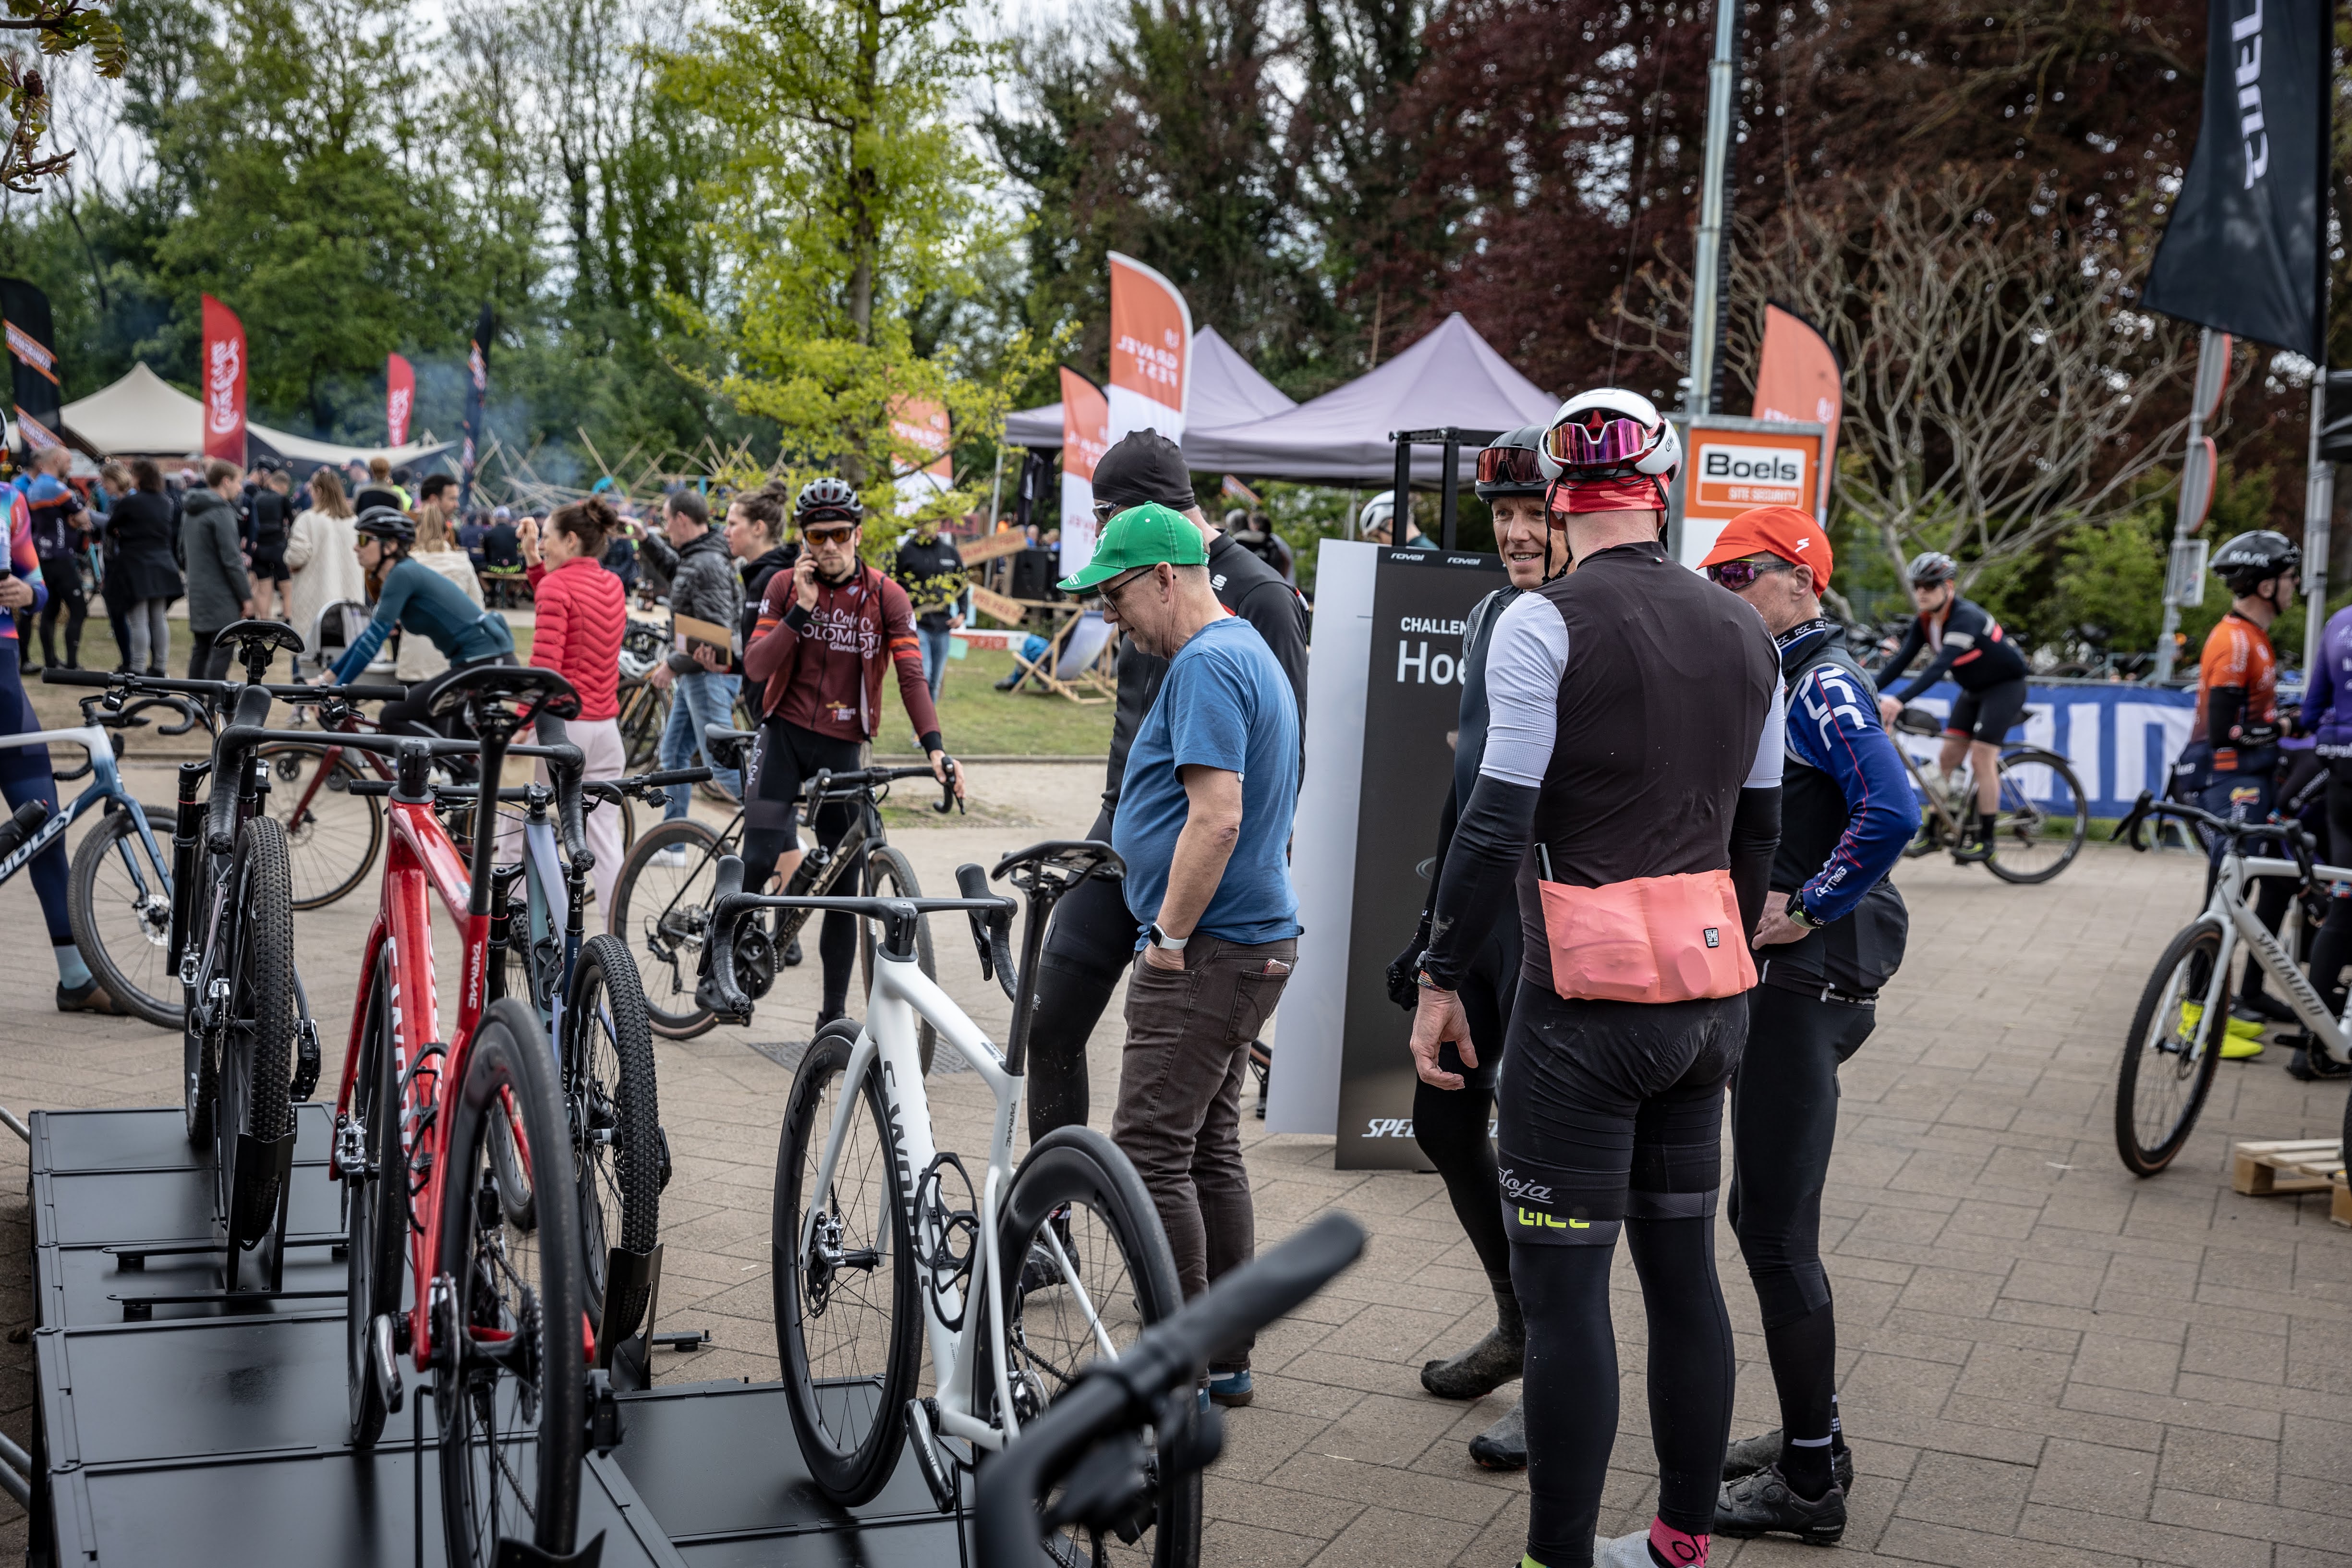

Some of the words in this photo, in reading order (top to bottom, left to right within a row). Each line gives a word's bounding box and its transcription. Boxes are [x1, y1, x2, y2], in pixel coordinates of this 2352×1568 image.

[1707, 453, 1796, 480] Boels
[1728, 486, 1749, 501] SITE
[1751, 487, 1798, 502] SECURITY
[1391, 553, 1425, 561] roval
[1447, 557, 1481, 566] roval
[468, 940, 482, 1009] TARMAC
[2256, 932, 2324, 1016] SPECIALIZED
[1006, 1100, 1017, 1149] TARMAC
